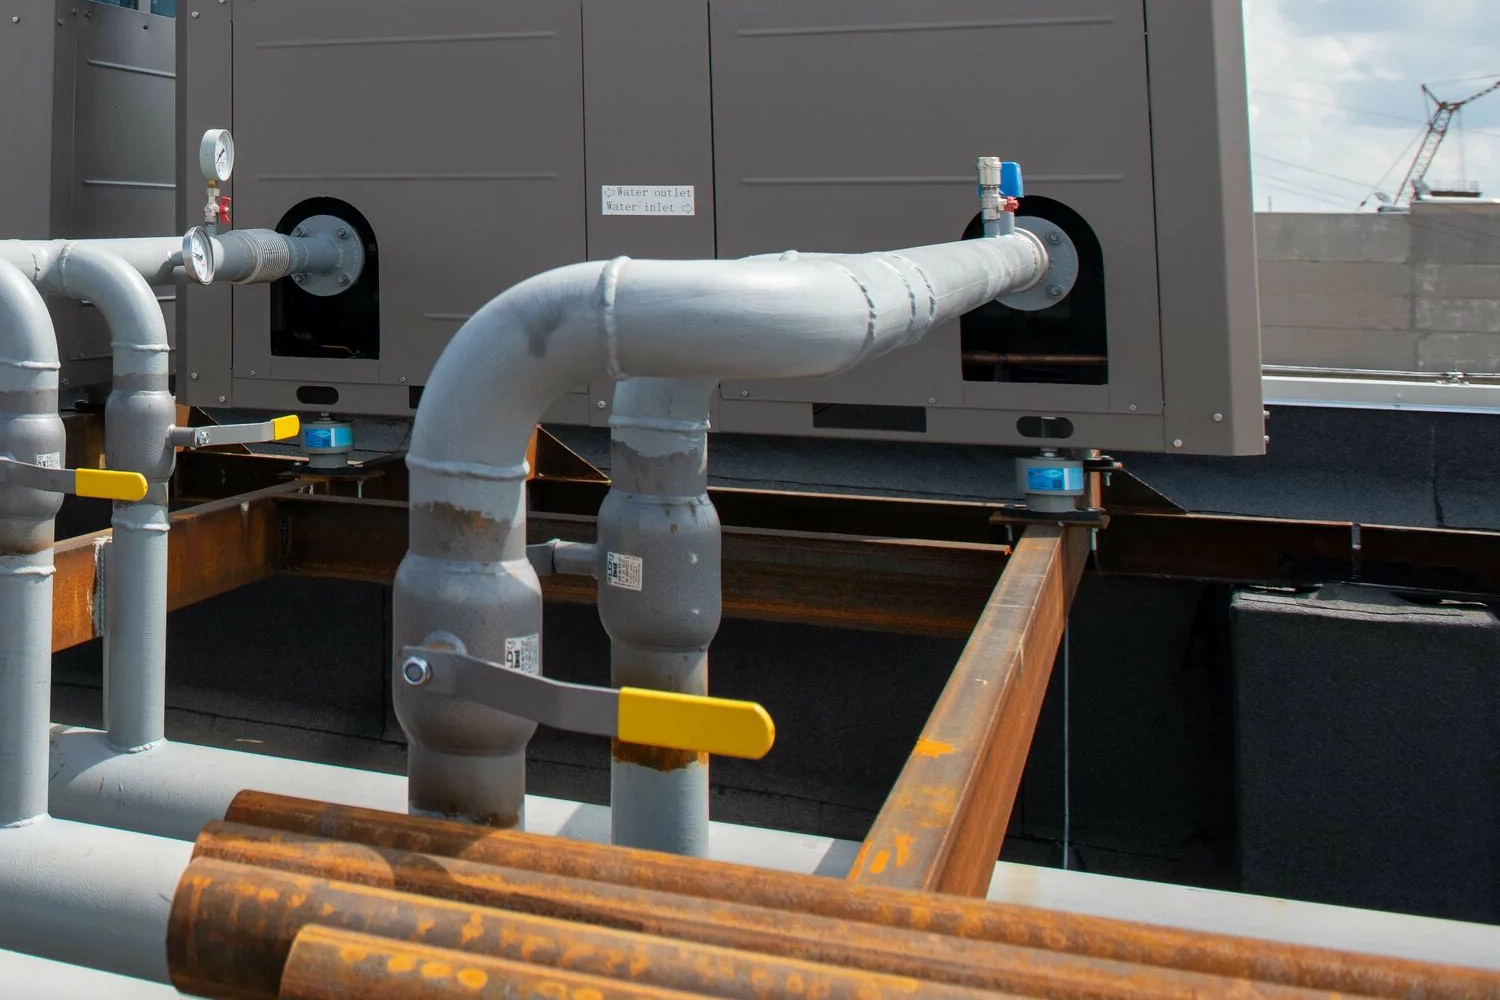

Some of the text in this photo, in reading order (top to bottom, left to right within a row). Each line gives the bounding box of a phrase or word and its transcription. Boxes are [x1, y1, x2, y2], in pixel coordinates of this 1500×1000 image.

[616, 186, 692, 198] Water outlet
[606, 201, 675, 212] Water inlet
